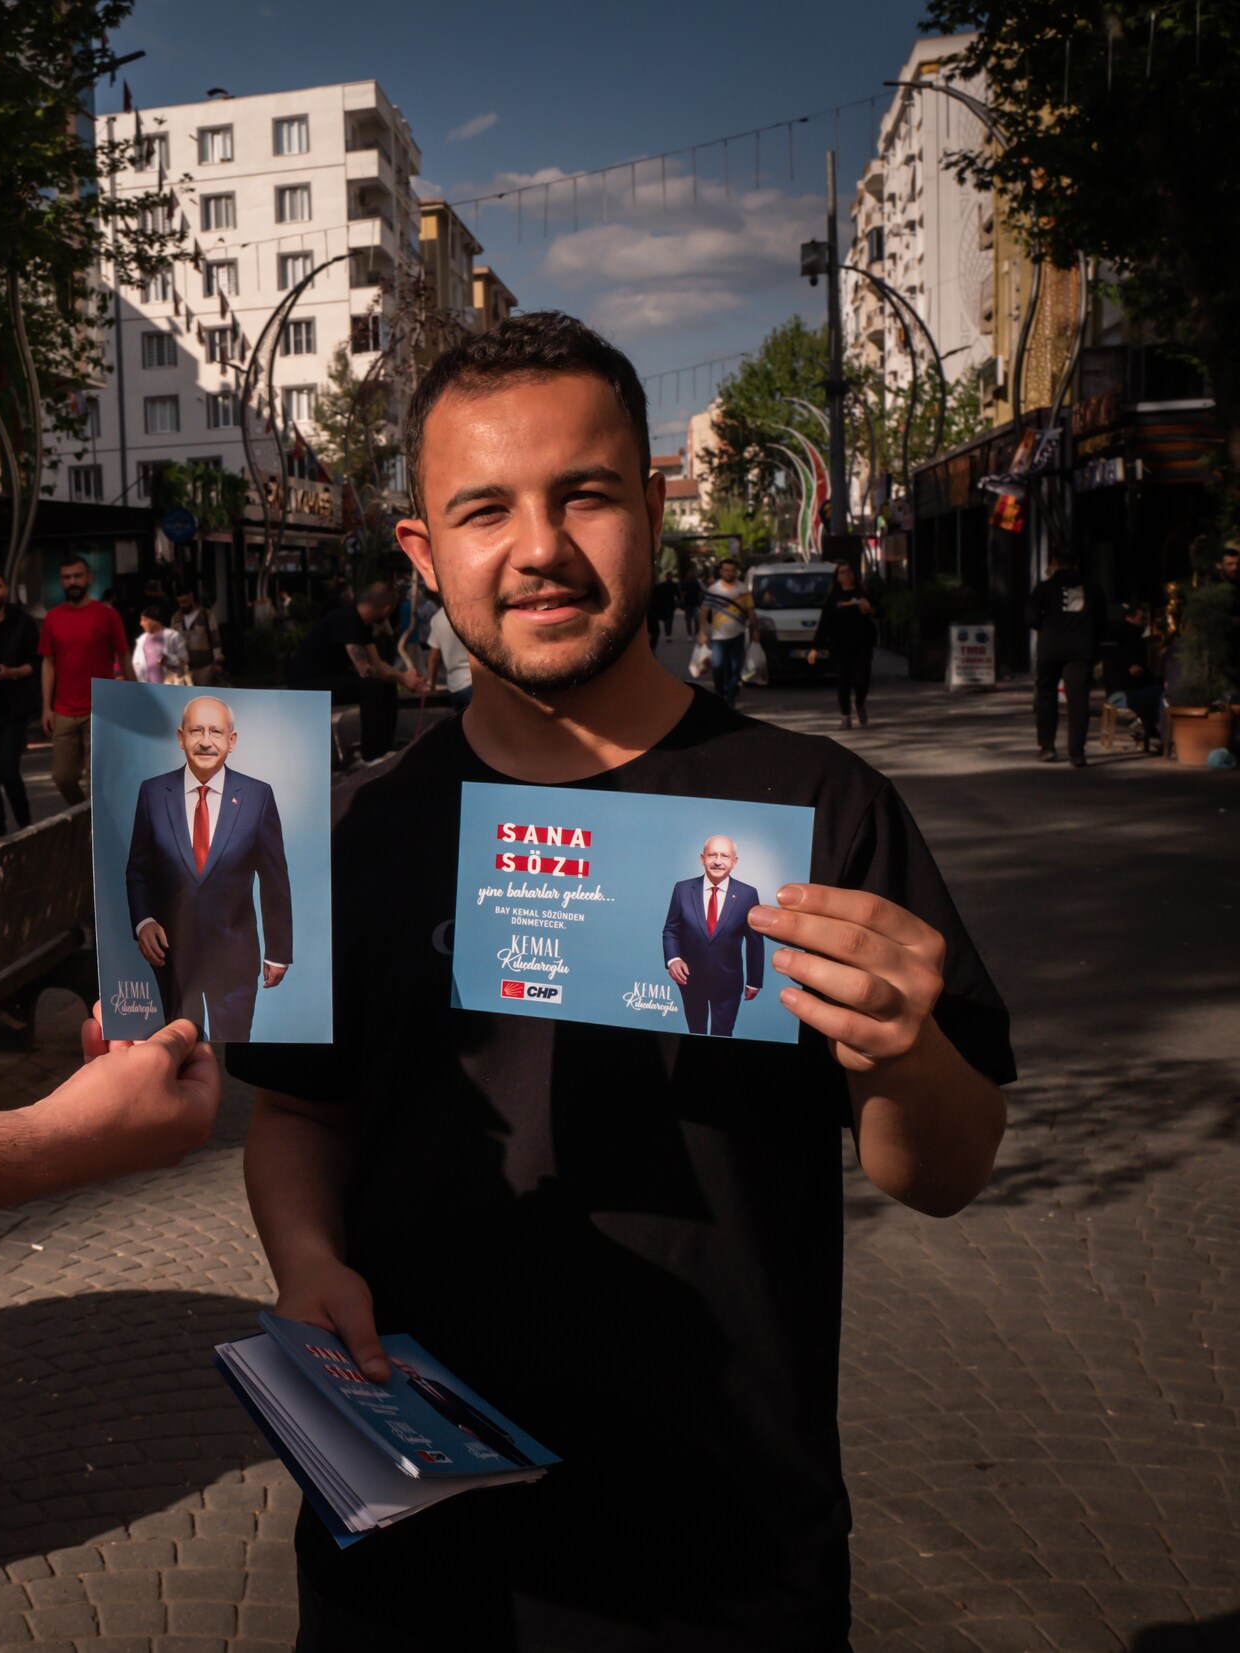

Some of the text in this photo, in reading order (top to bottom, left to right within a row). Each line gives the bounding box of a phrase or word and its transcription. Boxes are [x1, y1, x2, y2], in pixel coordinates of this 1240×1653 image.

[502, 823, 586, 848] SANA
[501, 850, 584, 878] SÖZ!
[477, 882, 615, 908] yine baharlar gelecek...
[495, 906, 585, 921] BAY KEMAL SÖZÜNDEN
[511, 916, 567, 929] DÖNMEYECEK.
[511, 934, 561, 958] KEMAL
[118, 980, 150, 999] KEMAL
[527, 986, 558, 999] CHP
[634, 981, 672, 1001] KEMAL
